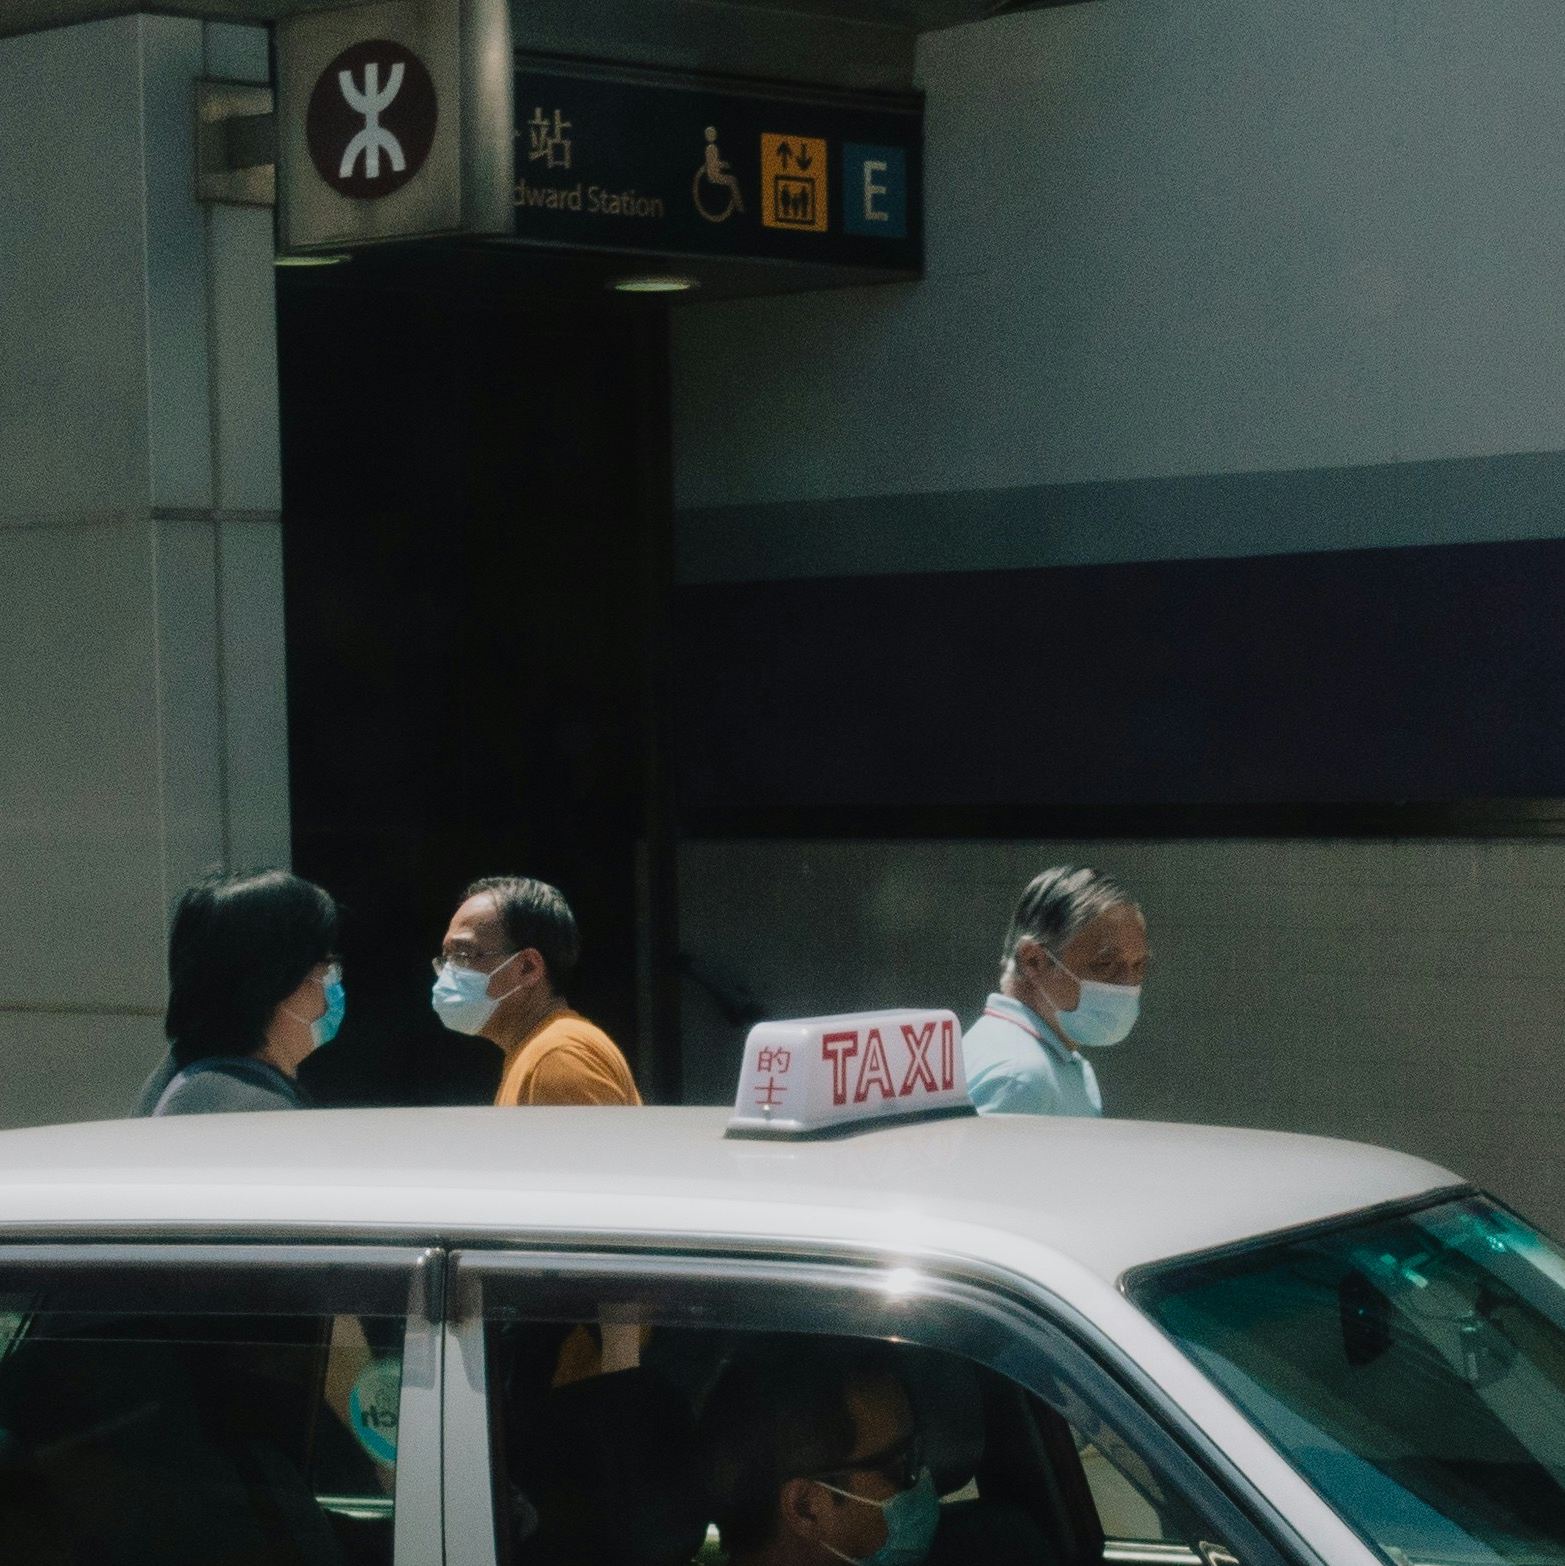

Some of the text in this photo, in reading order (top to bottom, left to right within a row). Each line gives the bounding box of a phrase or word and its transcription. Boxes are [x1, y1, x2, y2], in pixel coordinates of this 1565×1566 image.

[514, 106, 572, 169] 站
[514, 178, 666, 218] dward Station
[863, 160, 888, 222] E
[753, 1046, 792, 1107] 的士
[821, 1019, 955, 1106] TAXI
